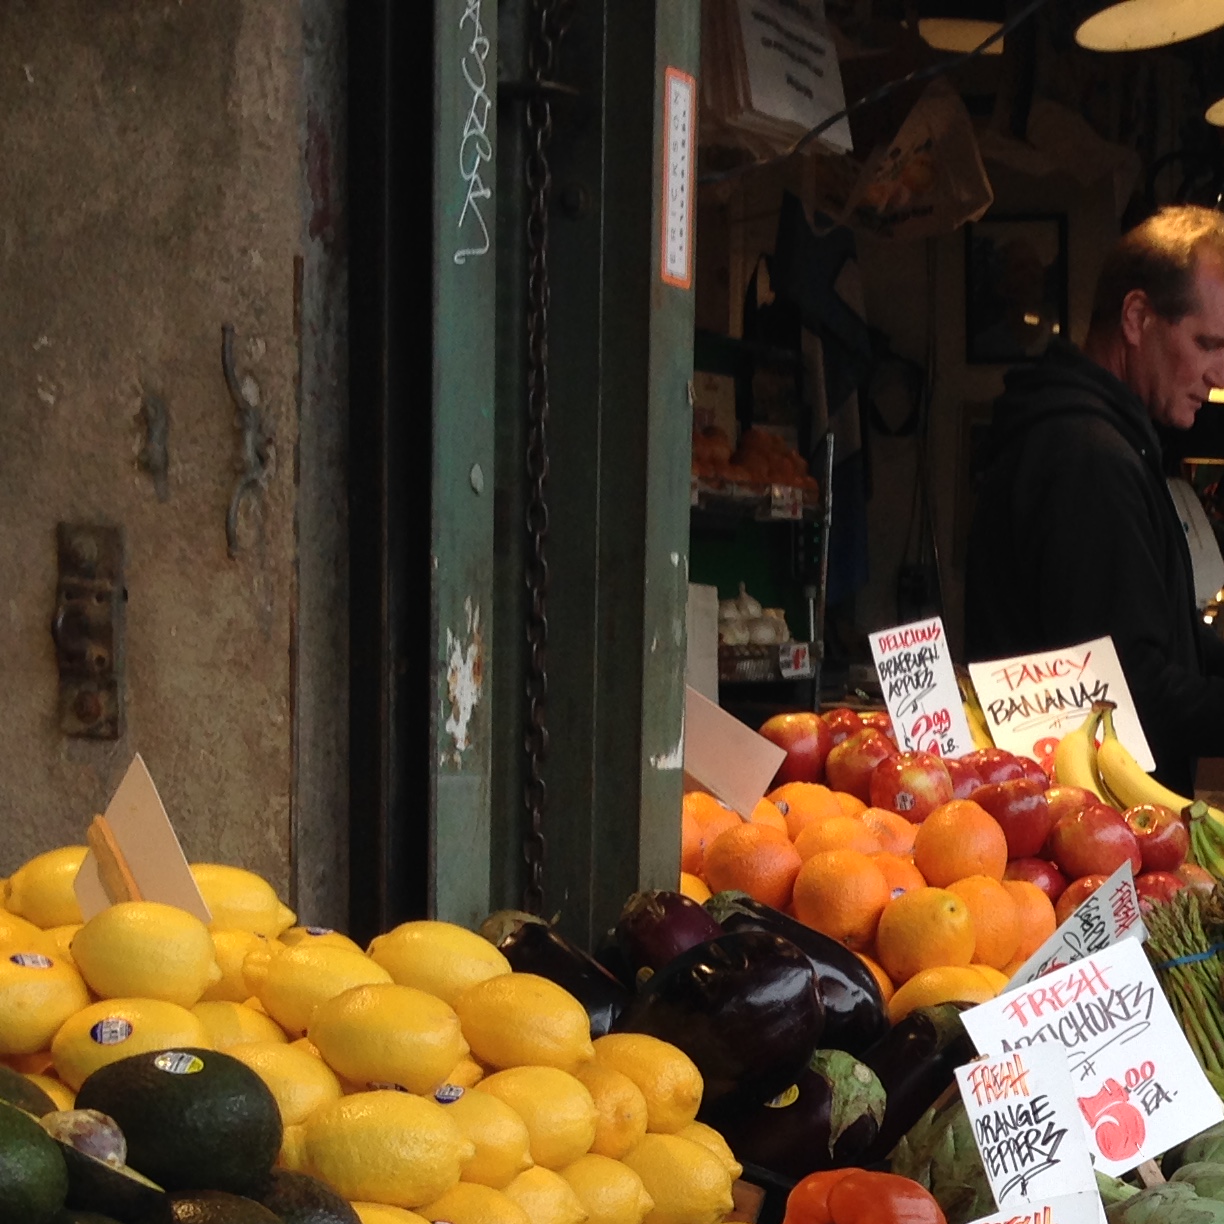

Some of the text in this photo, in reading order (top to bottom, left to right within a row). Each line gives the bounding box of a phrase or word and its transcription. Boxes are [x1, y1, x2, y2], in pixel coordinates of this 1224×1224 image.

[879, 621, 941, 654] DELICIOUS
[888, 667, 934, 702] APPLES
[991, 651, 1091, 691] FANCY
[988, 680, 1109, 726] BANANAS
[1109, 881, 1139, 938] FRESH
[1003, 961, 1112, 1027] FRESH
[967, 1054, 1031, 1107] FRESH
[975, 1095, 1056, 1146] ORANGE
[982, 1122, 1067, 1181] PEPPERS
